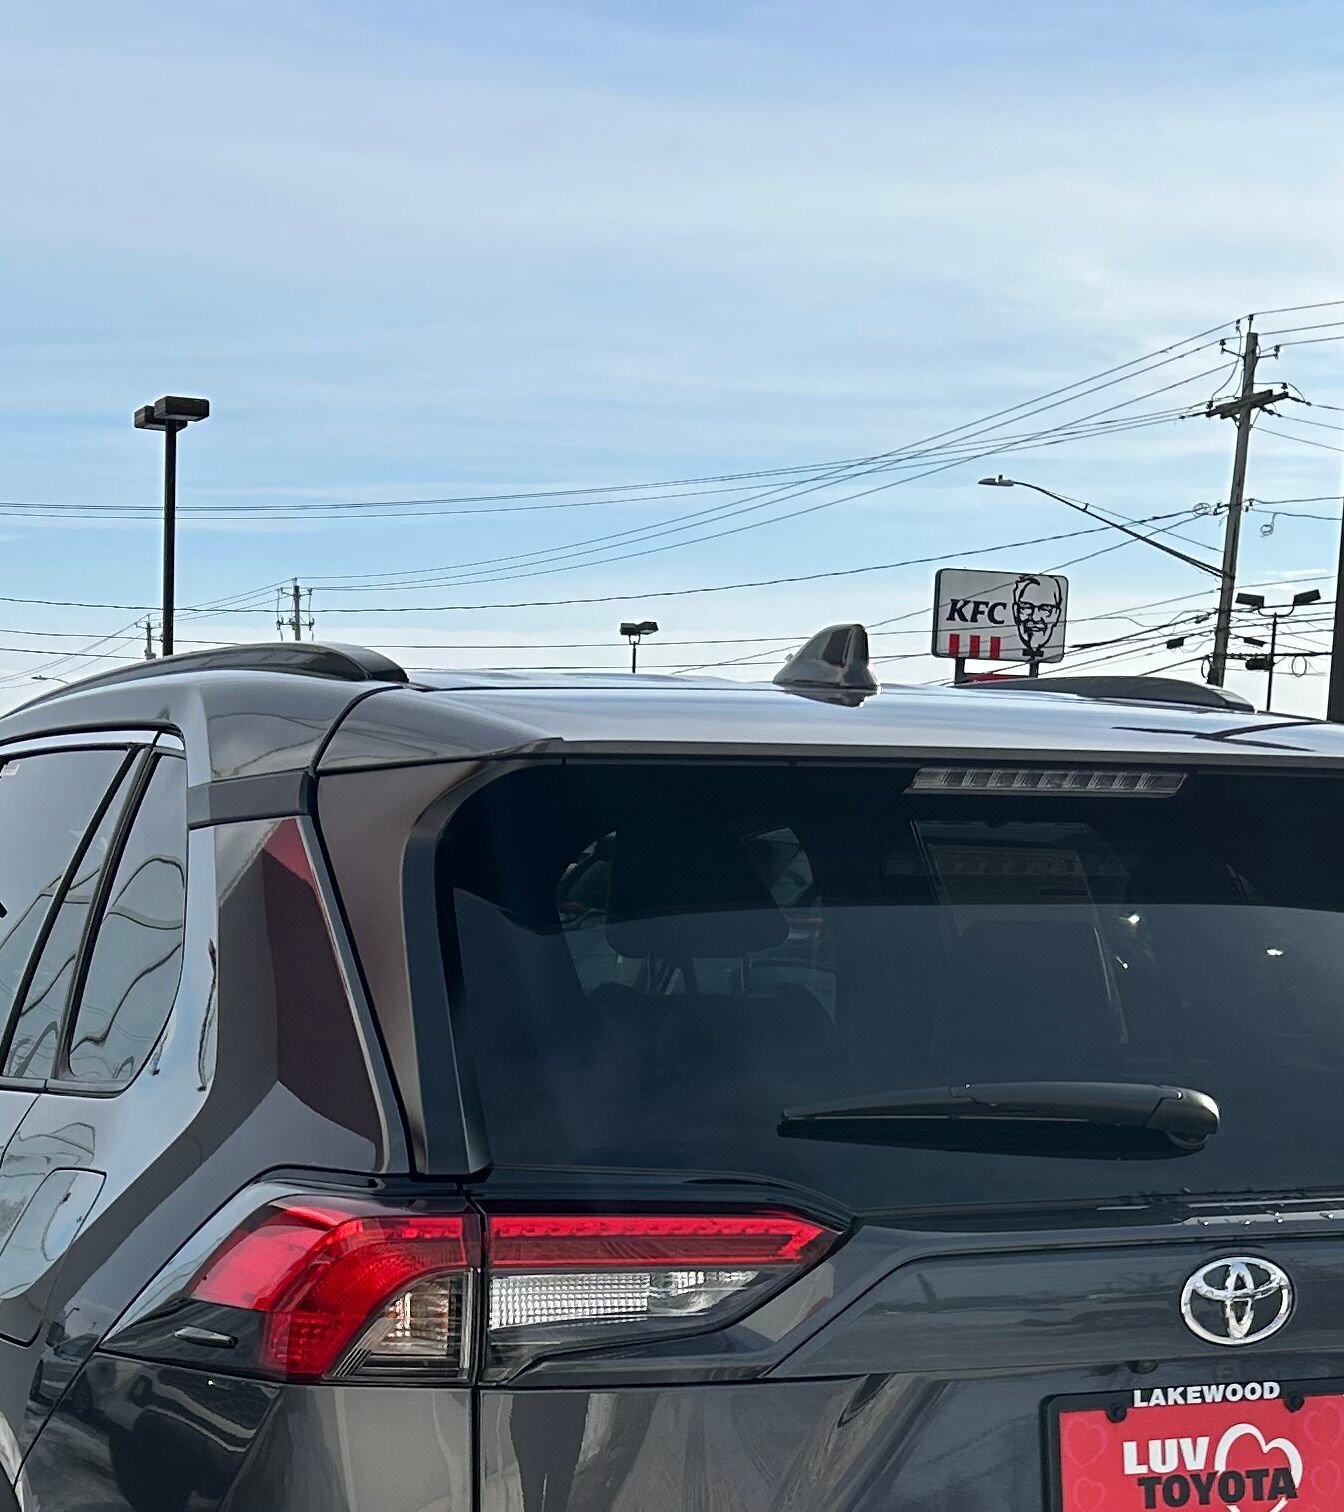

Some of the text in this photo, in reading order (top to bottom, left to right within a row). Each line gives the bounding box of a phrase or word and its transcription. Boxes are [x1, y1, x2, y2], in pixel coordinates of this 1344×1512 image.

[946, 599, 1006, 625] KFC
[1133, 1381, 1281, 1408] LAKEWOOD
[1122, 1436, 1210, 1475] LUV
[1137, 1468, 1298, 1509] TOYOTA
